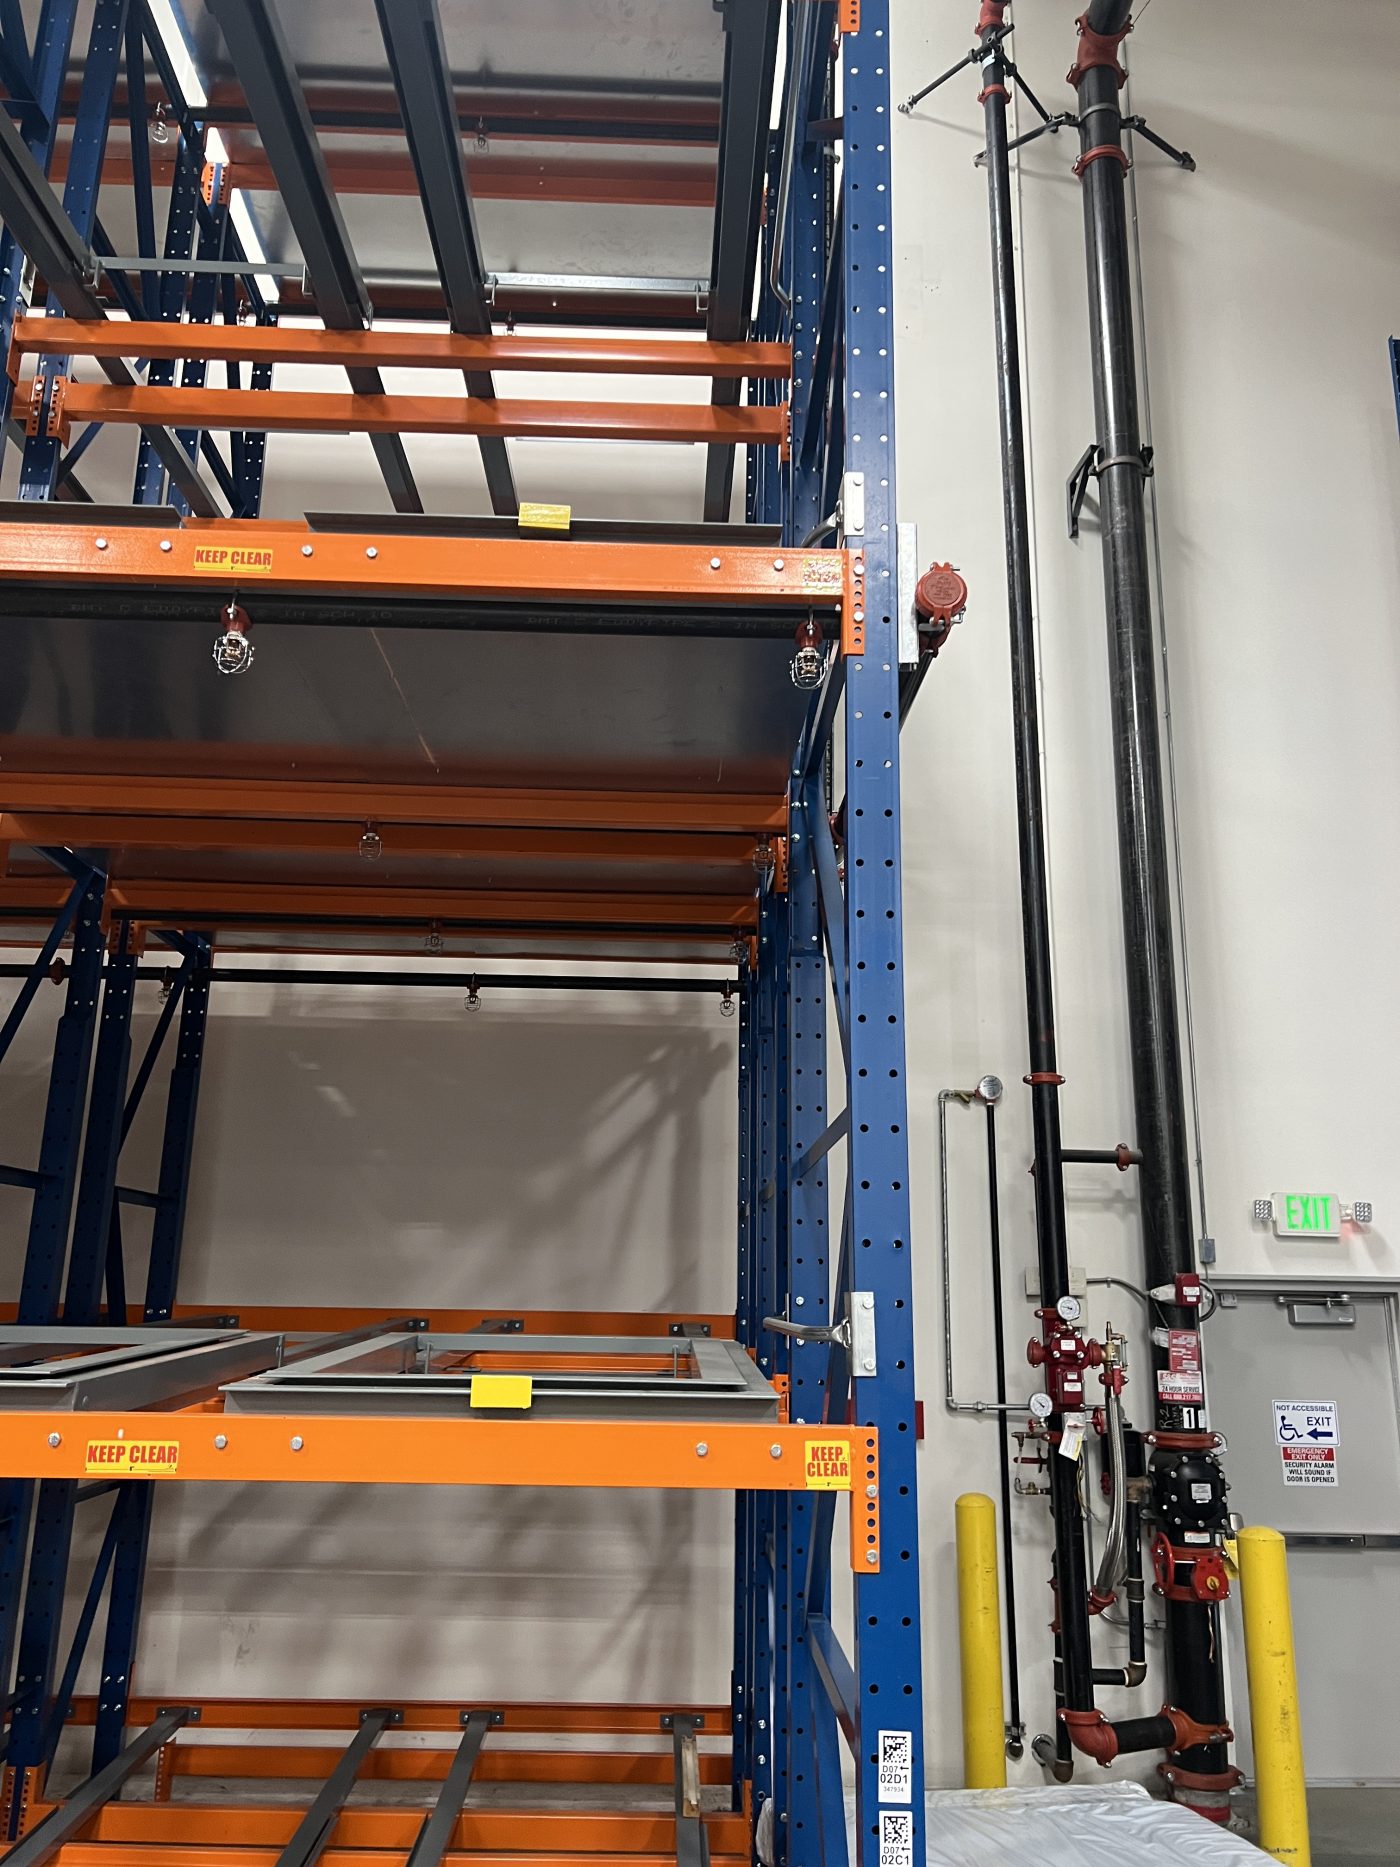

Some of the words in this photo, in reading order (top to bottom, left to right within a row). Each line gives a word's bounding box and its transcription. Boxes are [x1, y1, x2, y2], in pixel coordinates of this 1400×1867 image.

[195, 549, 228, 563] KEEP
[231, 551, 271, 566] CLEAR
[1286, 1194, 1332, 1232] EXIT
[1186, 1409, 1192, 1428] 1
[1306, 1416, 1332, 1427] EXIT
[87, 1445, 126, 1463] KEEP
[129, 1445, 178, 1464] CLEAR
[811, 1446, 843, 1461] KEEP
[807, 1462, 848, 1477] CLEAR
[882, 1765, 898, 1773] D07
[880, 1773, 908, 1784] 02D1
[883, 1846, 900, 1854] D07
[881, 1855, 909, 1866] 02C1
